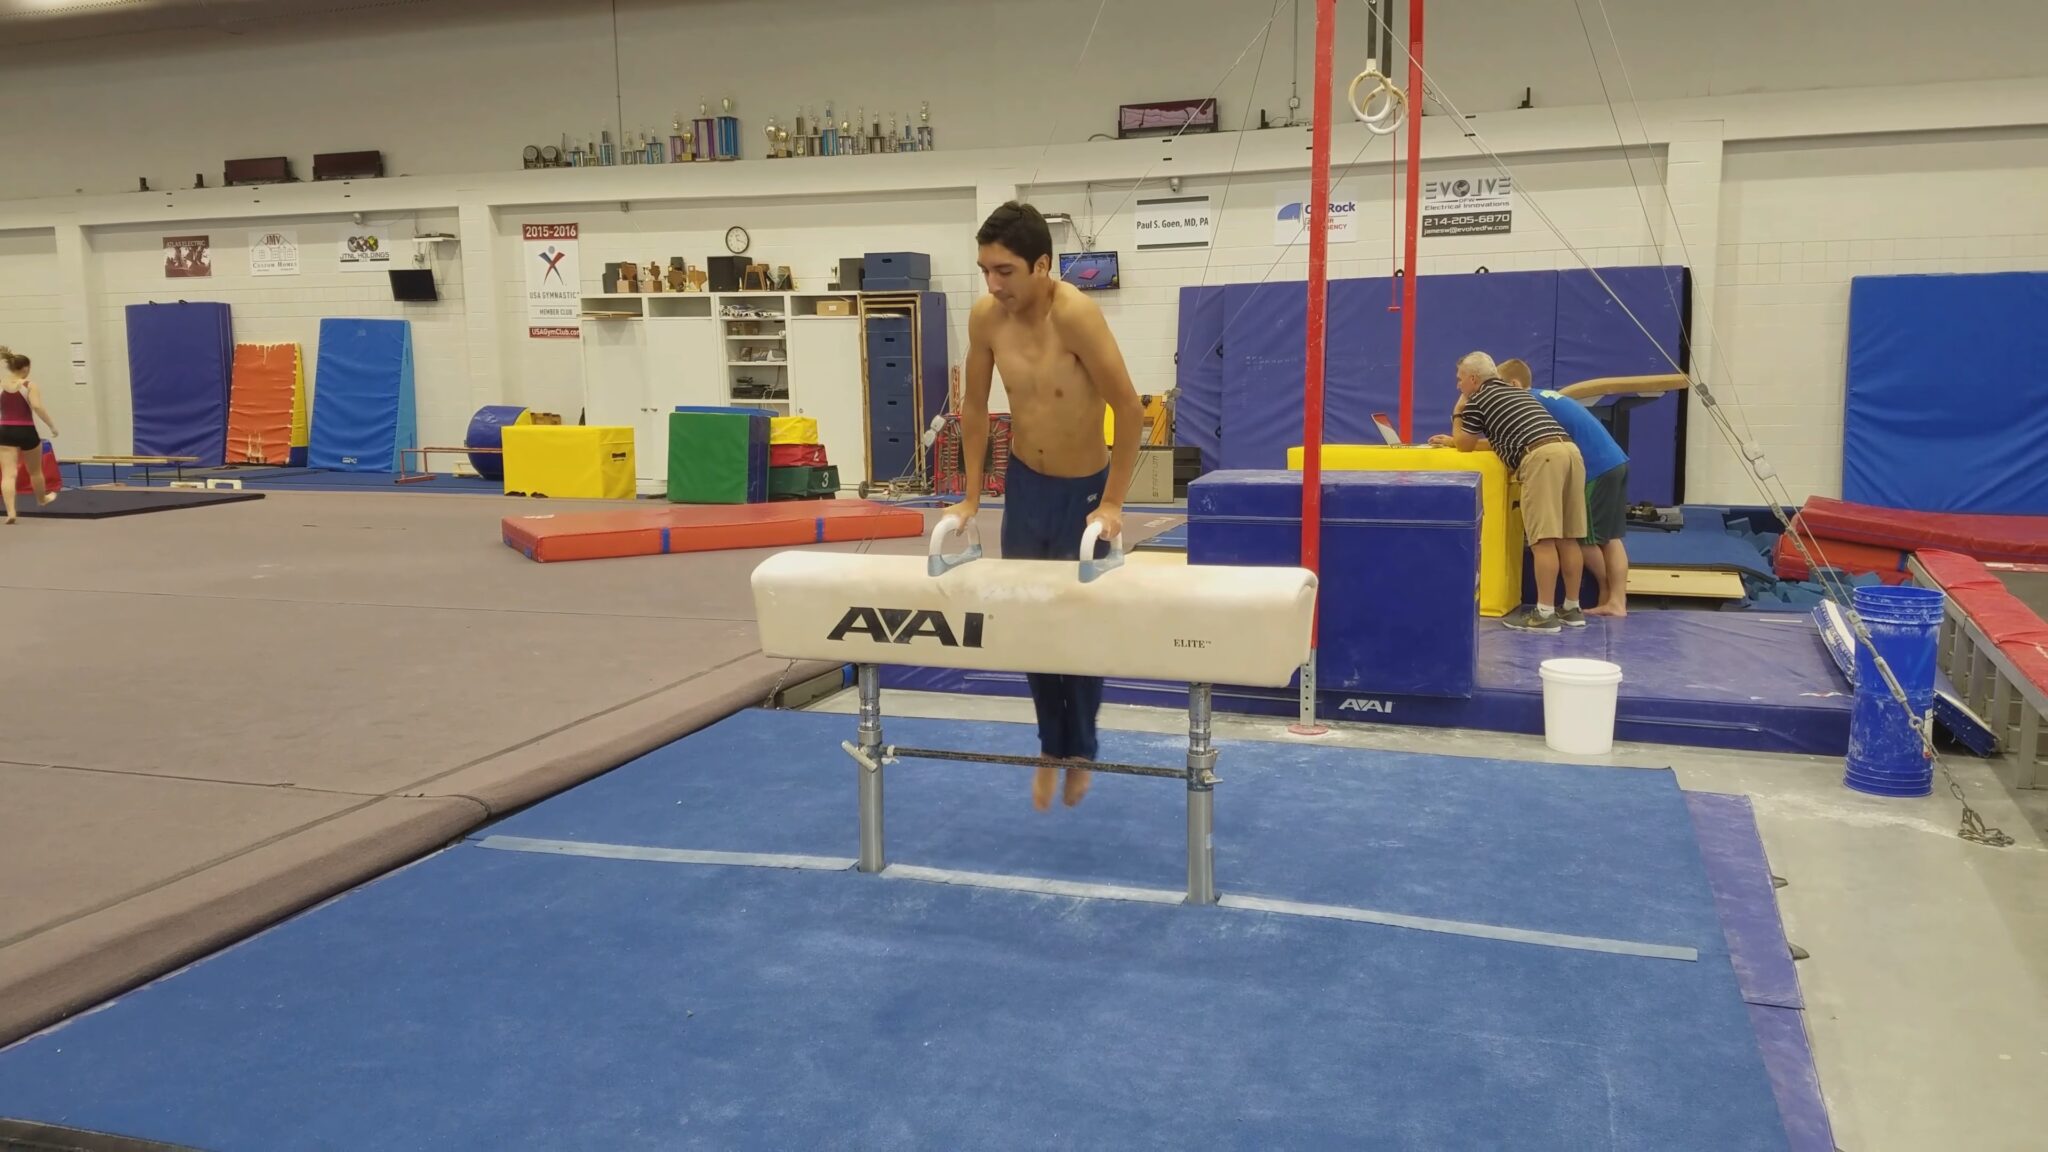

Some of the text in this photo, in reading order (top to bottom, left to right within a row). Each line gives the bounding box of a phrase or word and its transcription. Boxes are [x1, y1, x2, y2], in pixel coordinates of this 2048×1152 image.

[1305, 201, 1356, 214] CRock
[1136, 217, 1209, 230] Paul S. Goen, MD, PA
[1424, 214, 1510, 226] 214-205-6870
[525, 225, 577, 238] 2015-2016
[1424, 225, 1509, 236] jamesw@evolvedfw.com
[264, 235, 281, 246] JMV
[542, 291, 580, 299] GYMNASTIC
[821, 472, 829, 488] 3
